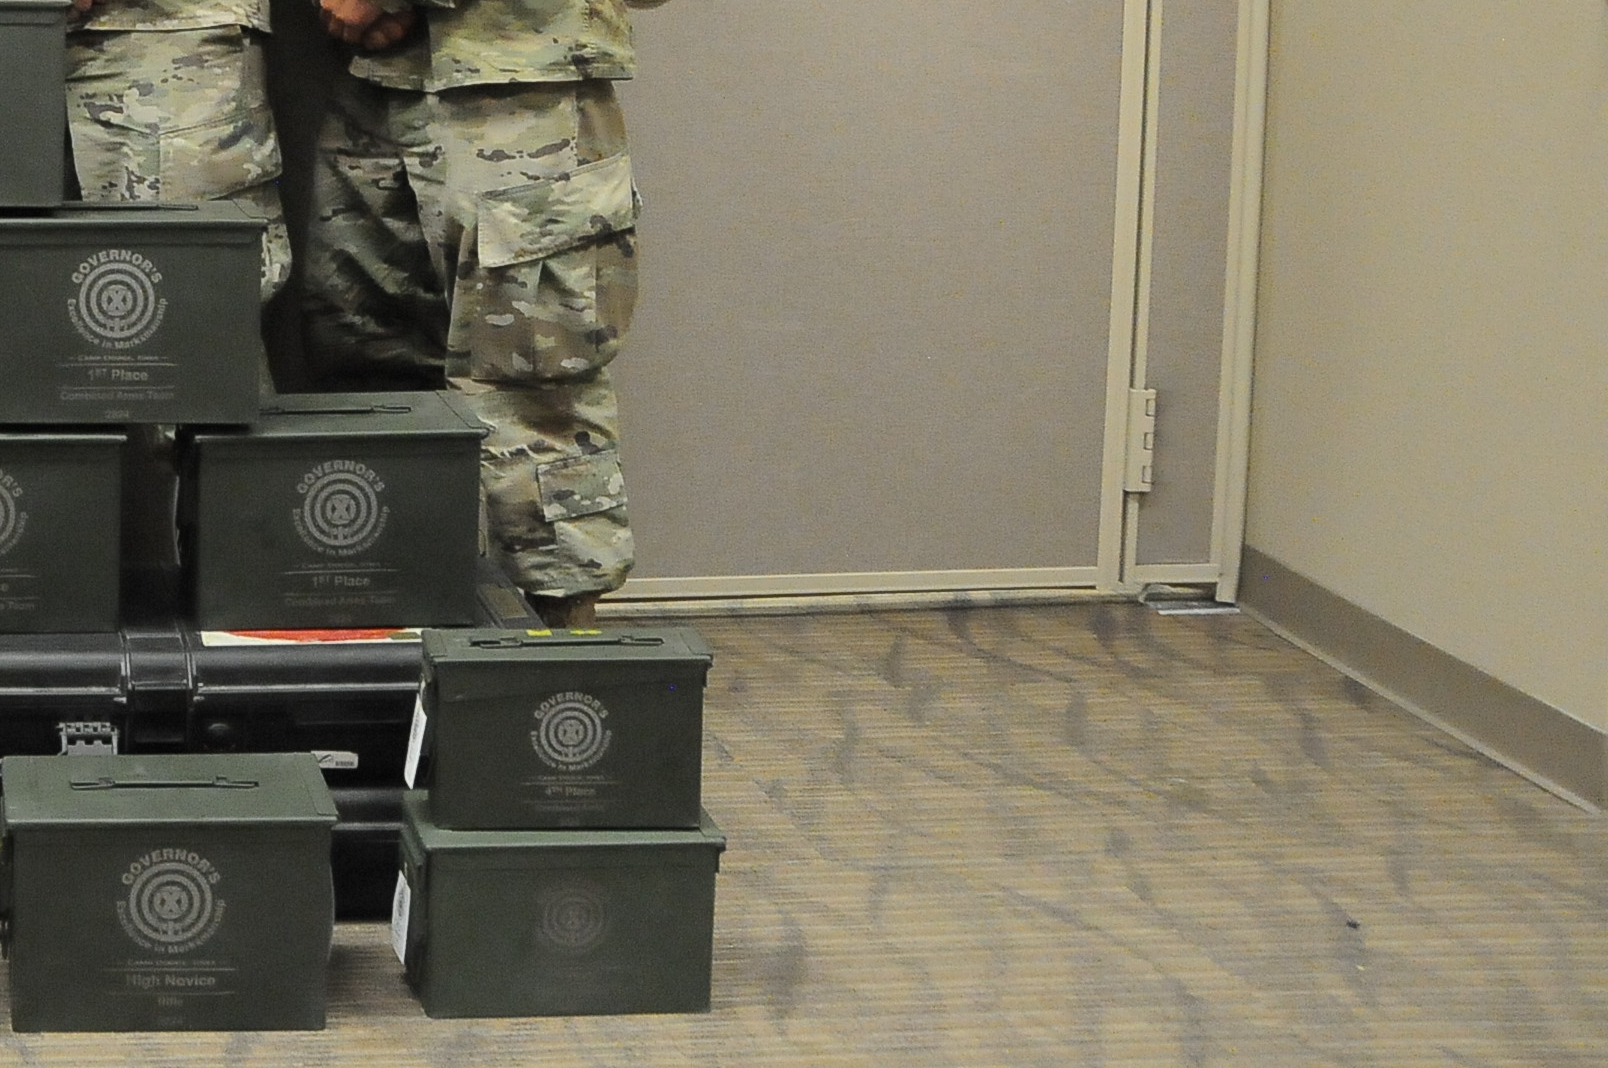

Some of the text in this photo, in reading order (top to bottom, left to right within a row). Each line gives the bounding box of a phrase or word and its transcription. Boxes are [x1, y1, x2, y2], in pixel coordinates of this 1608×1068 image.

[72, 249, 163, 284] GOVERNOR'S
[111, 368, 149, 381] Place
[297, 460, 386, 493] GOVERNOR'S
[334, 575, 371, 587] Place
[534, 692, 609, 720] GOVERNOR'S
[121, 848, 221, 885] GOVERNOR'S
[164, 973, 217, 988] Novice
